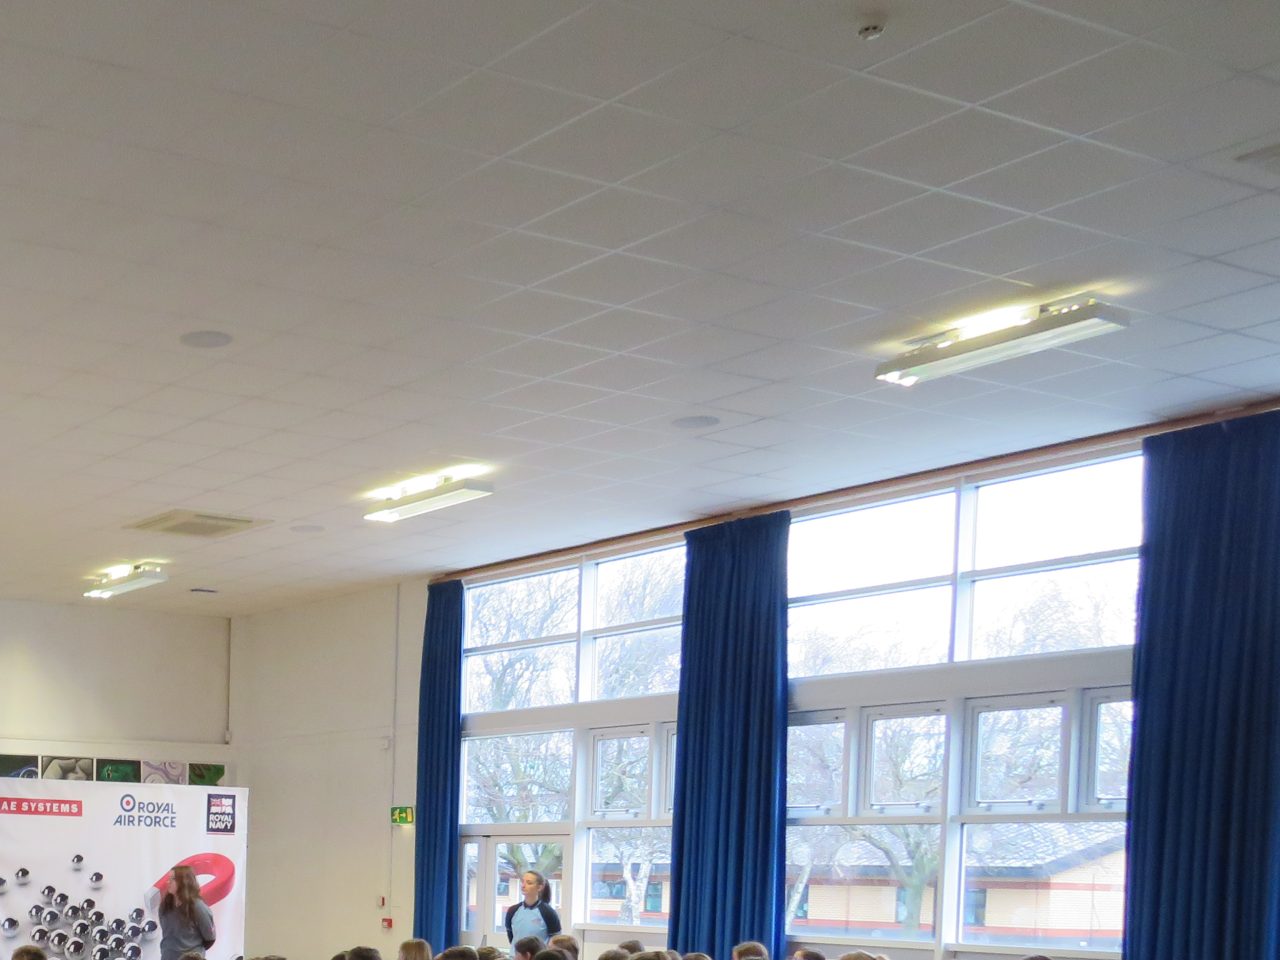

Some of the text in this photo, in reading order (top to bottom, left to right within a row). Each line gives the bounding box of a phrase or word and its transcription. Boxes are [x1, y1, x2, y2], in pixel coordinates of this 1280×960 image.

[21, 802, 79, 813] SYSTEMS
[137, 801, 176, 814] ROYAL
[113, 815, 176, 828] AIR FORCE
[209, 814, 233, 822] ROYAL
[209, 820, 232, 829] NAVY
